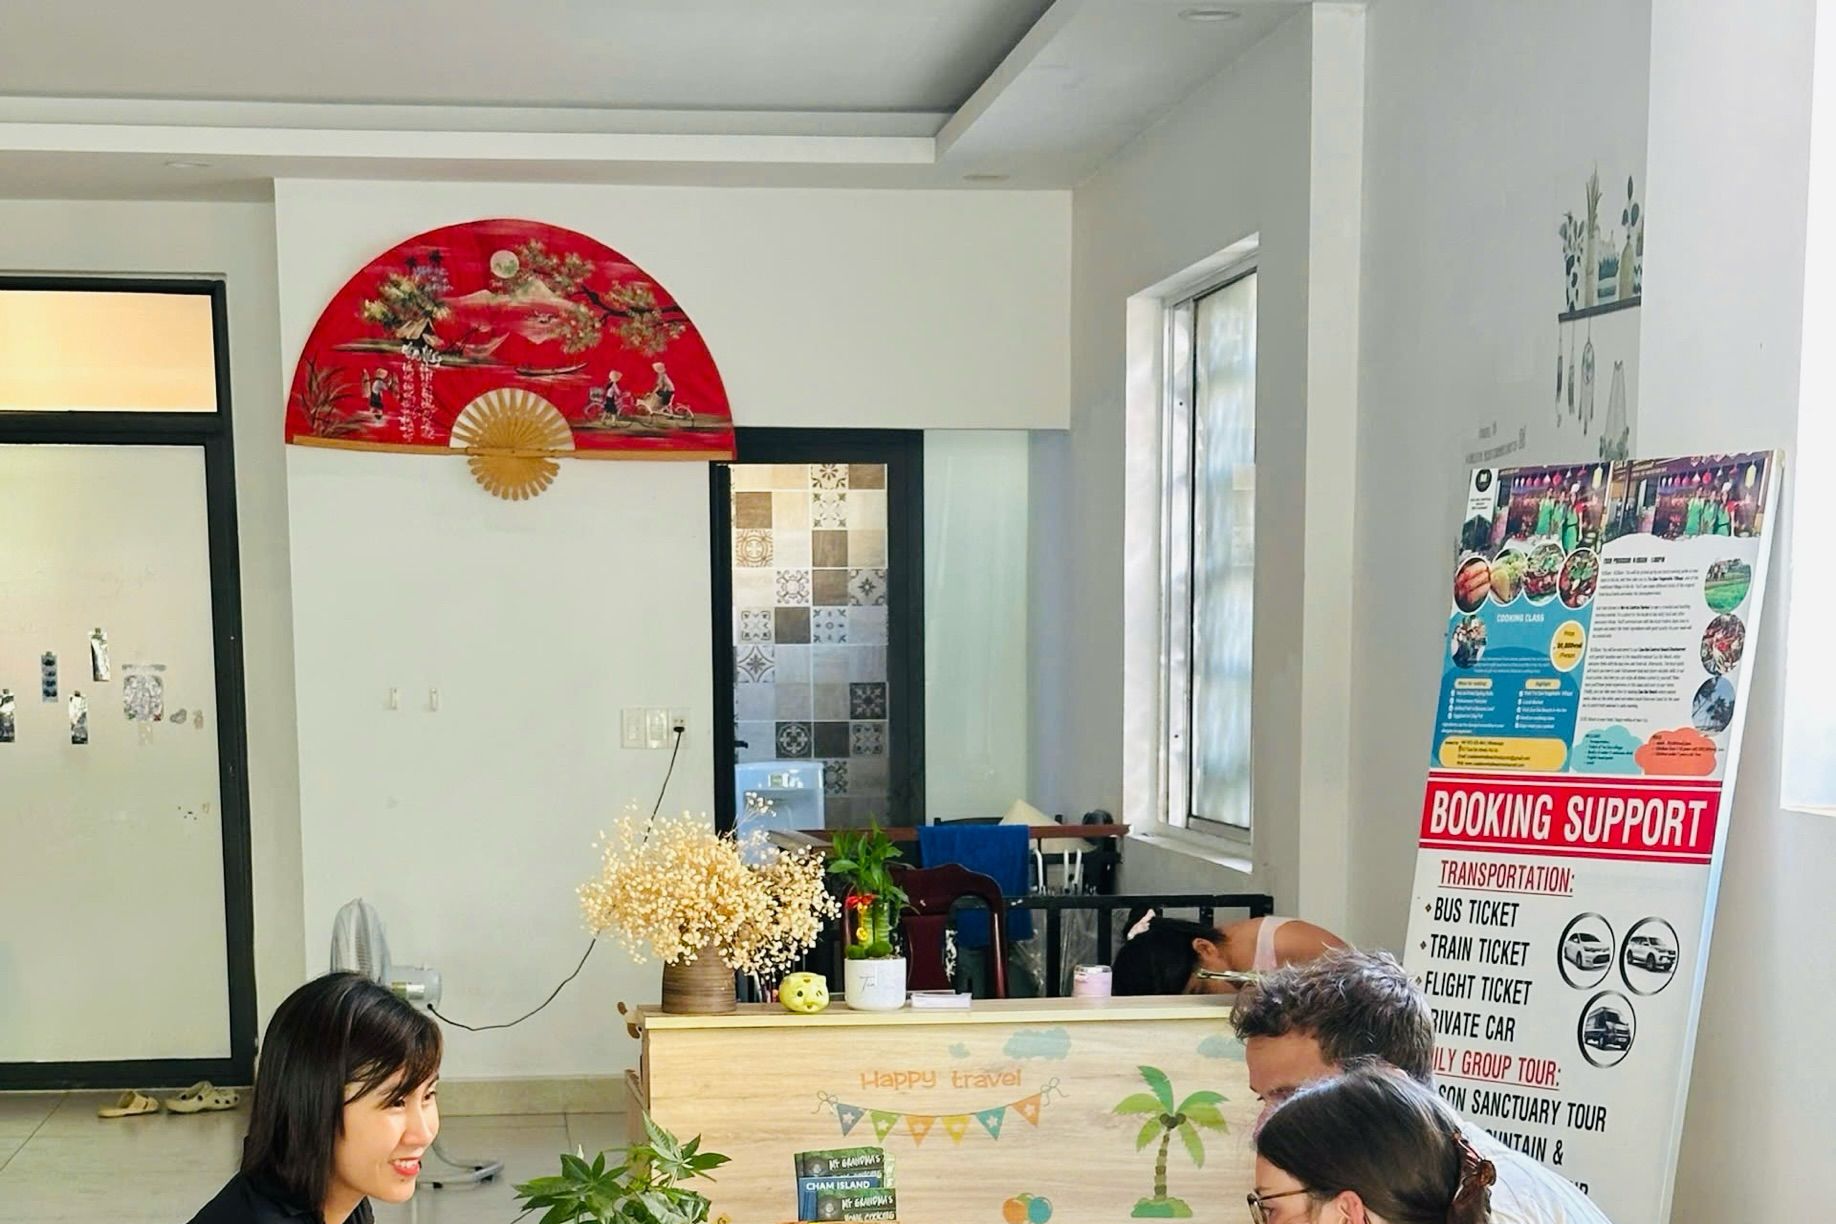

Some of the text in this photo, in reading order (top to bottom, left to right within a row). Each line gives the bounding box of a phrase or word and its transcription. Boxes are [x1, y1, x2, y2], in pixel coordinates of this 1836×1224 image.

[1525, 613, 1545, 623] CLASS
[1430, 790, 1708, 847] BOOKING SUPPORT
[1440, 860, 1575, 893] TRANSPORTATION:
[1434, 897, 1520, 927] BUS TICKET
[1430, 933, 1530, 967] TRAIN TICKET
[1424, 970, 1533, 1006] FLIGHT TICKET
[1430, 1008, 1516, 1042] RIVATE CAR
[859, 1068, 1022, 1090] Happy travel
[1432, 1047, 1561, 1087] ILY GROUP TOUR:
[1471, 1089, 1561, 1125] SANCTUARY
[1567, 1102, 1607, 1132] TOUR
[1552, 1139, 1563, 1165] &
[806, 1180, 871, 1191] CHAM ISLAND
